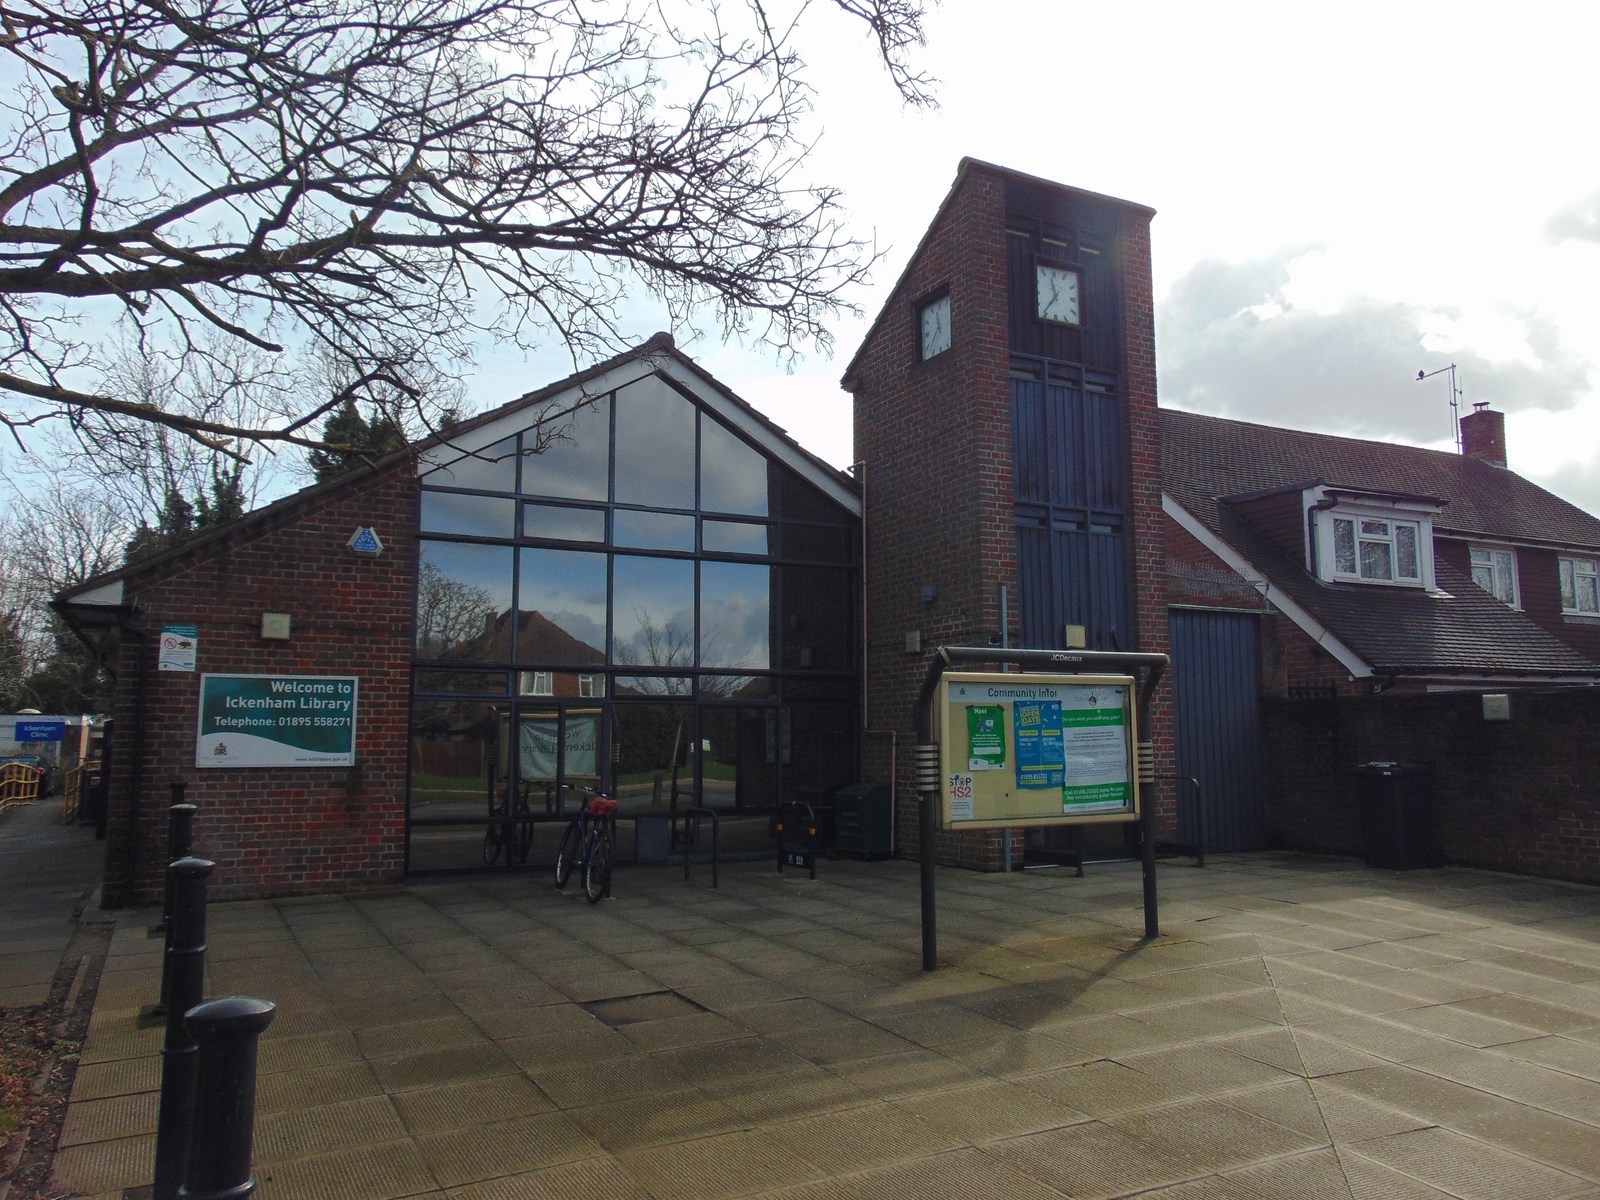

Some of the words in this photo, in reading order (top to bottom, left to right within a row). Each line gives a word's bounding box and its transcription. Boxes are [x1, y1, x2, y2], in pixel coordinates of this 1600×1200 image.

[1050, 653, 1083, 662] JCDecaux
[271, 680, 334, 694] Welcome
[338, 682, 351, 694] to
[988, 687, 1037, 700] Community
[226, 696, 296, 709] Ickenham
[300, 697, 351, 711] Library
[973, 707, 988, 715] Meet
[214, 716, 276, 728] Telephone:
[278, 716, 311, 727] 01895
[314, 716, 351, 727] 558271
[950, 775, 972, 787] STOP
